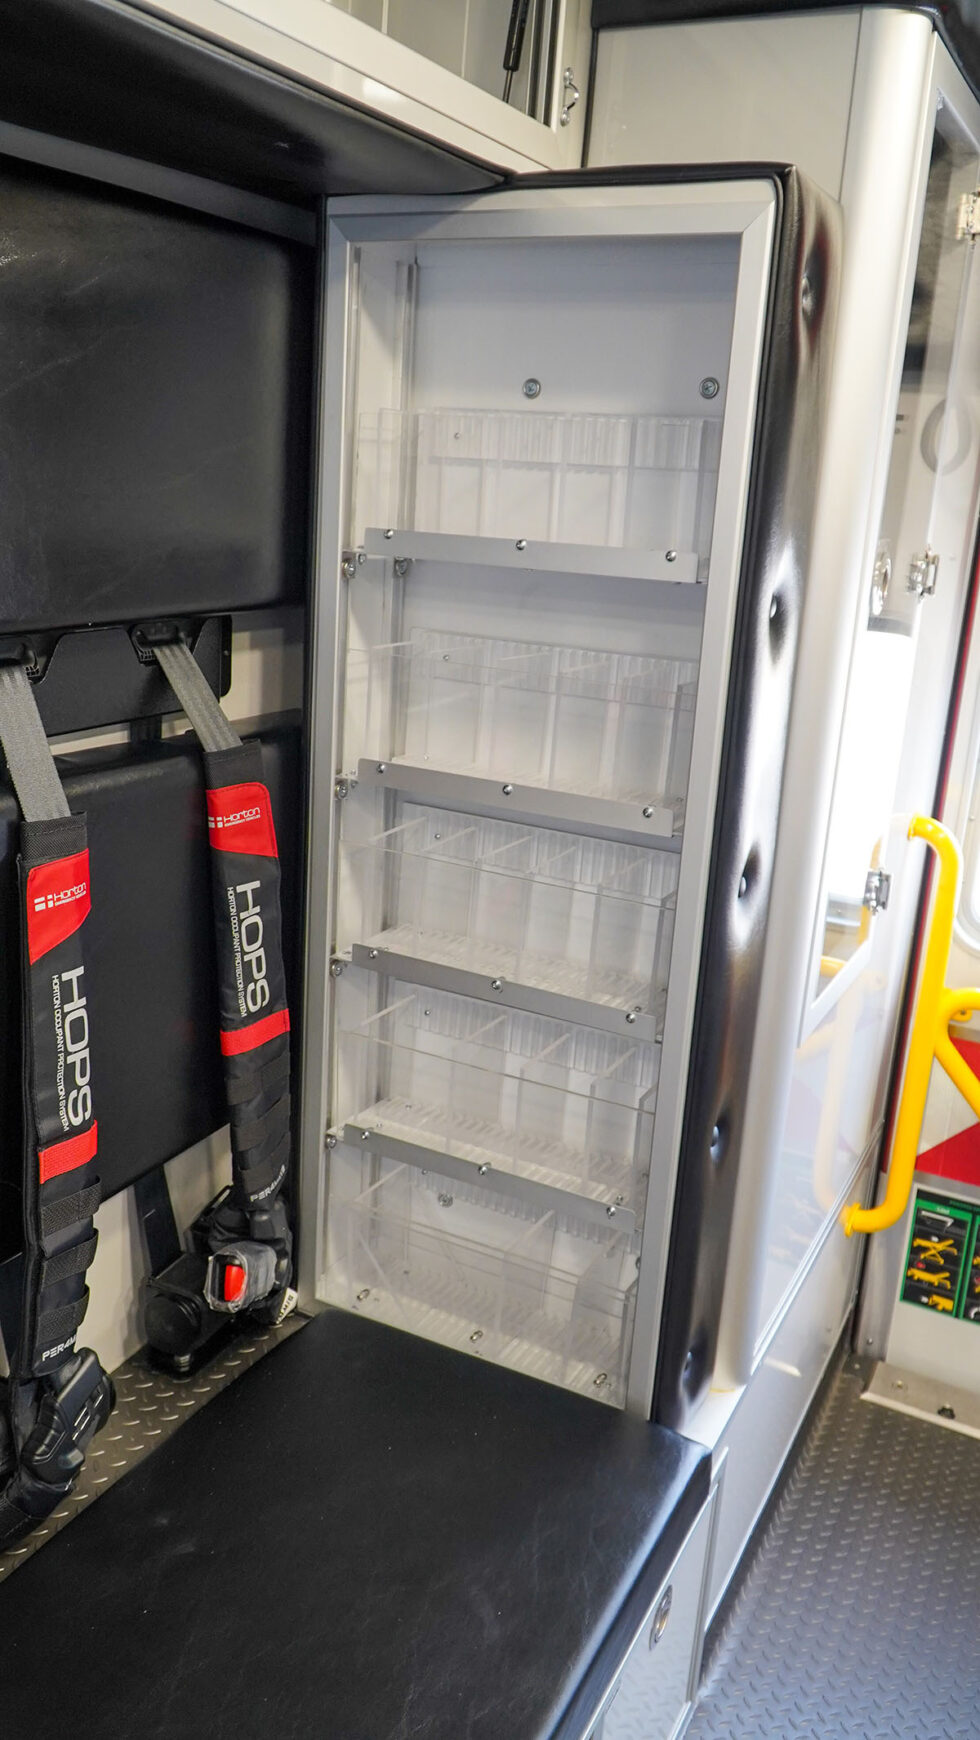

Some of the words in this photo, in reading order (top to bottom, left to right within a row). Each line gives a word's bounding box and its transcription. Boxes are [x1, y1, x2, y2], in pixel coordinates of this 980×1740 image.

[223, 807, 260, 823] Horton
[54, 882, 87, 901] Horton
[227, 886, 237, 916] HORTON
[236, 880, 270, 1013] HOPS
[52, 974, 61, 1009] HORTON
[54, 1008, 64, 1052] OCCUPANT
[61, 965, 92, 1126] HOPS
